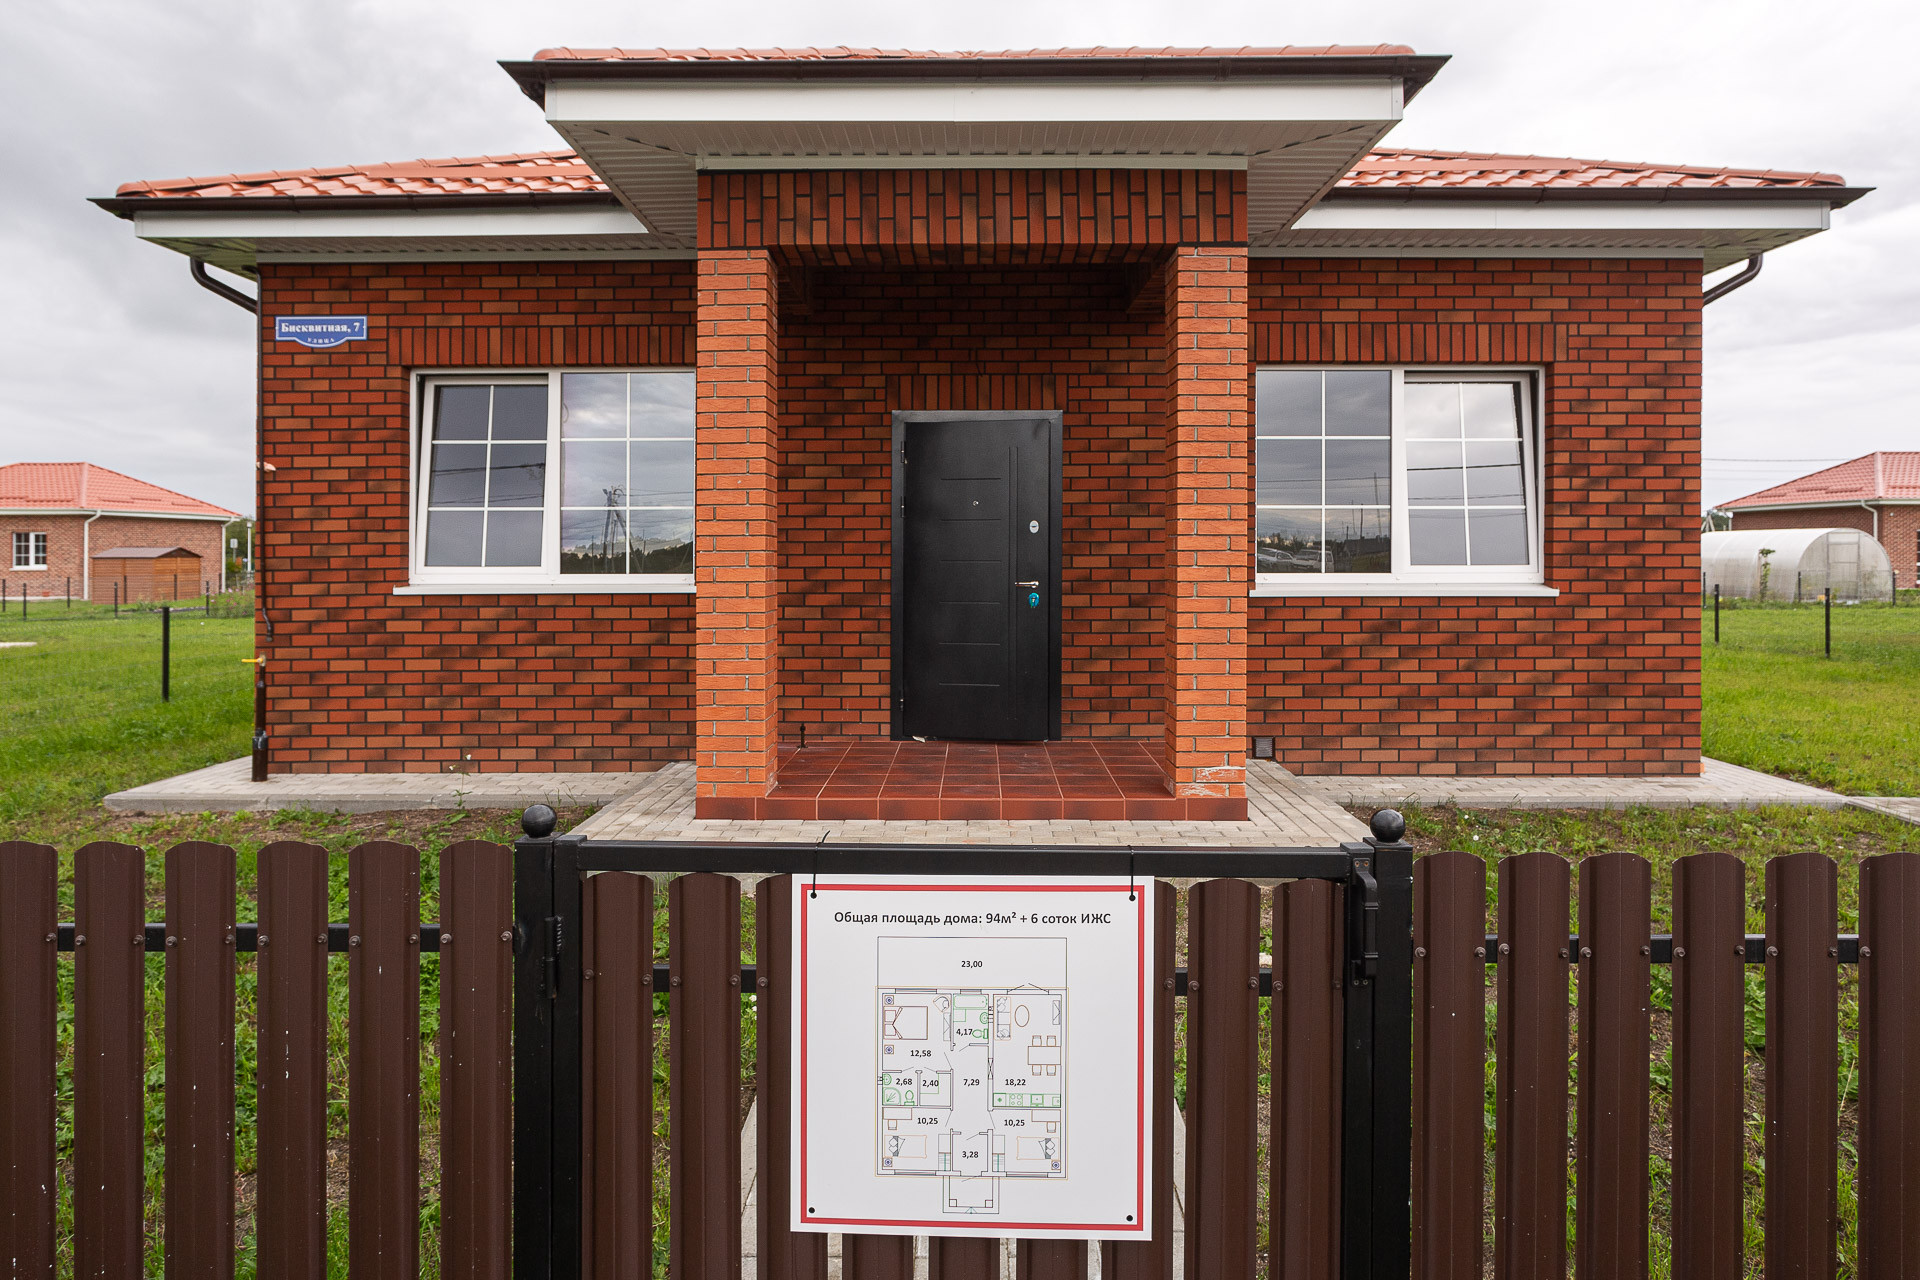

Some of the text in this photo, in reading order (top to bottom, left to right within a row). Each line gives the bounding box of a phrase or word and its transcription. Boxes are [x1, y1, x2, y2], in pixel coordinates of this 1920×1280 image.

[281, 322, 360, 333] Бисквитная, 7
[834, 912, 878, 924] Общая
[882, 914, 941, 925] площадь
[944, 914, 982, 925] дома:
[1020, 915, 1028, 923] +
[1031, 913, 1038, 924] 6
[1041, 915, 1077, 924] соток
[1081, 913, 1111, 924] ИЖС
[961, 960, 983, 969] 23,00
[956, 1028, 973, 1036] 4,17
[910, 1050, 932, 1058] 12,58
[895, 1078, 913, 1086] 2,68
[922, 1079, 939, 1087] 2,40
[963, 1078, 980, 1086] 7,29
[1004, 1078, 1026, 1086] 18,22
[917, 1117, 938, 1126] 10,25
[1003, 1119, 1025, 1127] 10,25
[962, 1150, 979, 1159] 3,28
